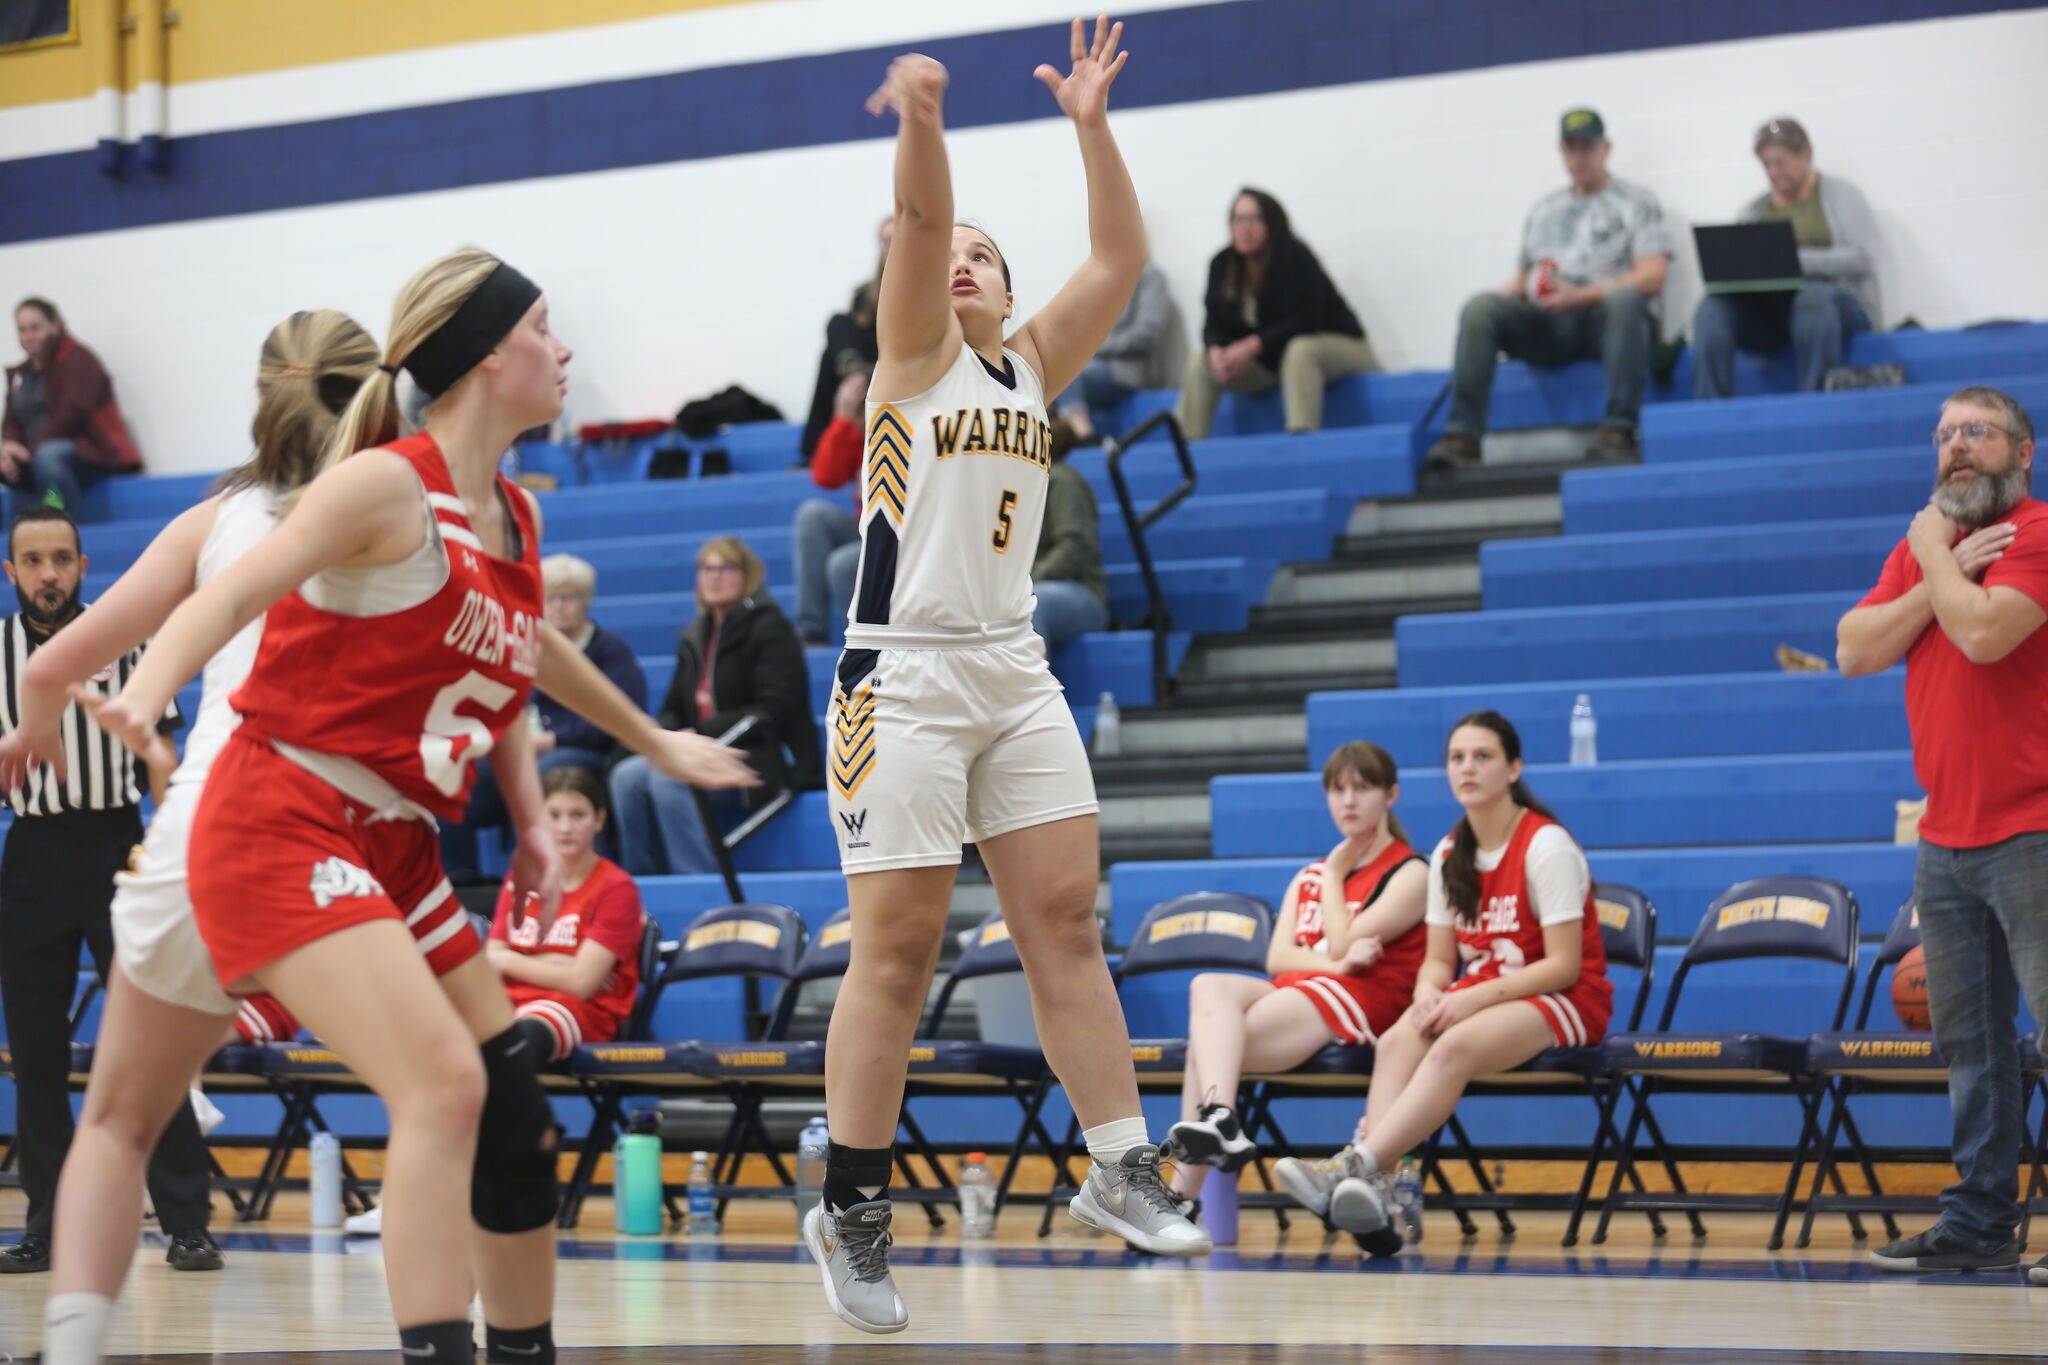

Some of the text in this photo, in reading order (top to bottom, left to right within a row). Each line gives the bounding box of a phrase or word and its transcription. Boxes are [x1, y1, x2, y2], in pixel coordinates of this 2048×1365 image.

[930, 408, 1052, 475] WARRIO
[992, 489, 1017, 555] 5
[1634, 1041, 1723, 1058] WARRIORS
[1840, 1041, 1933, 1058] WARRIORS
